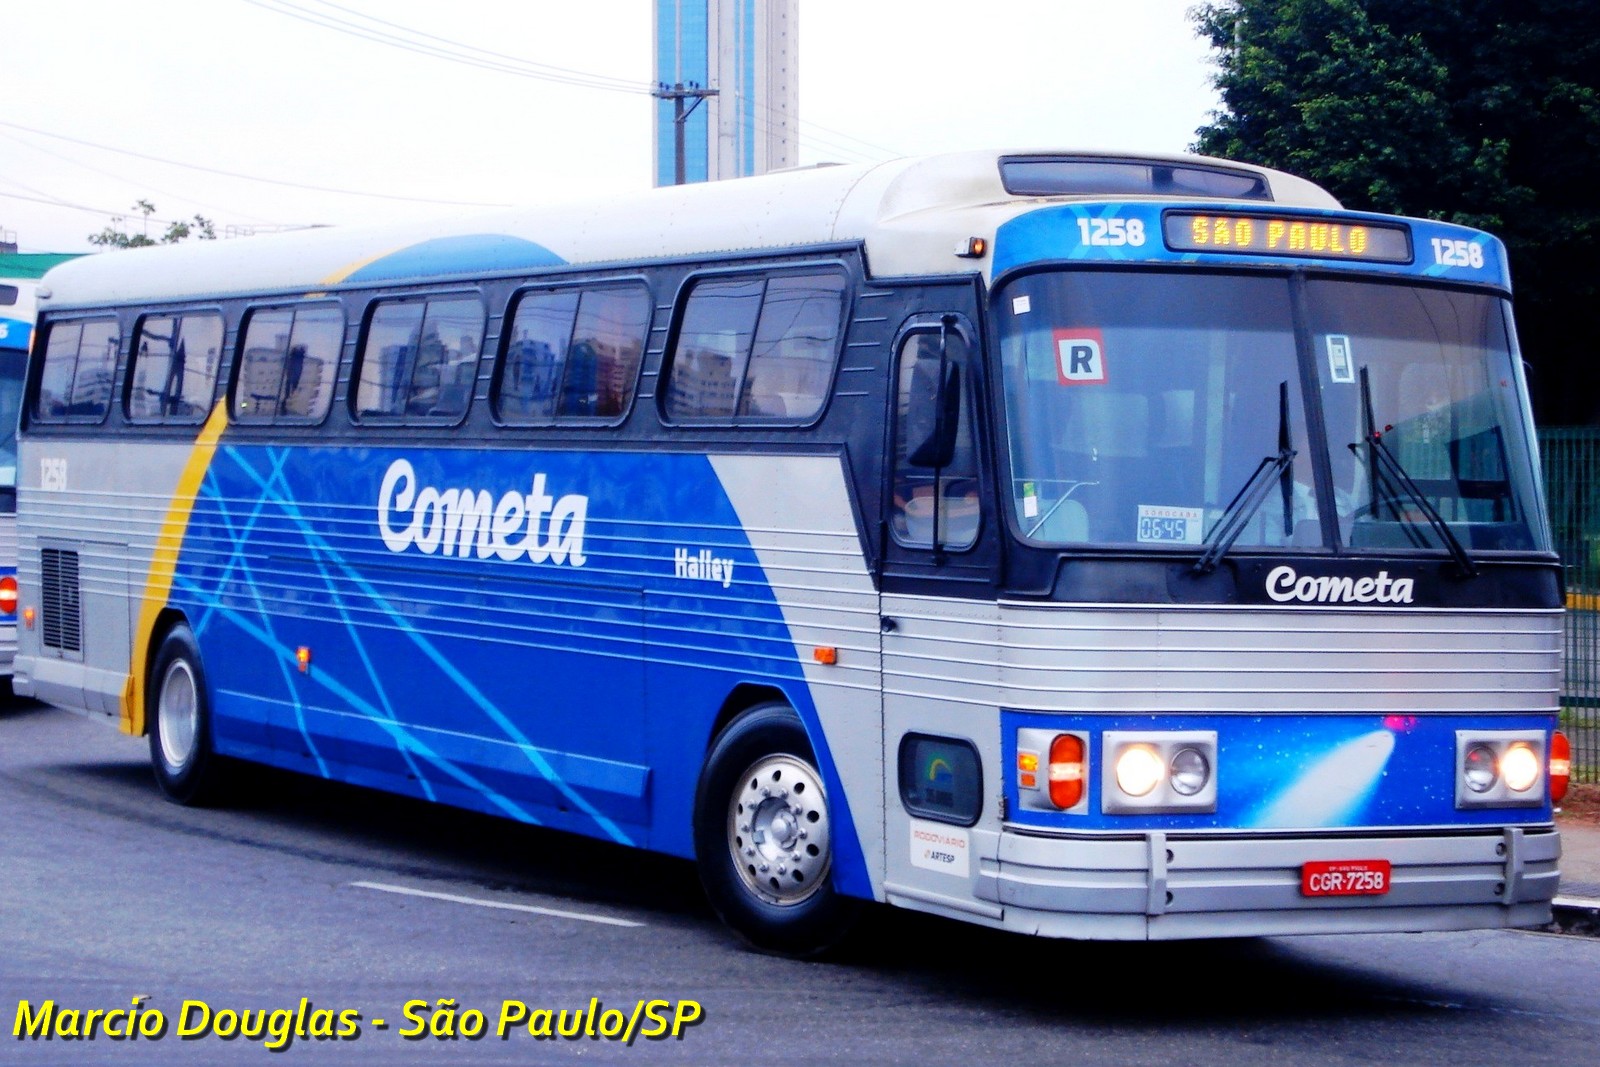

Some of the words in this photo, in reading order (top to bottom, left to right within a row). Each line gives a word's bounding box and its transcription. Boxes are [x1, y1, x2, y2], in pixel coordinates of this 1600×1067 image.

[1077, 217, 1146, 247] 1258
[1267, 220, 1368, 254] PAULO
[1431, 237, 1484, 269] 1258
[1070, 345, 1093, 374] R
[41, 457, 67, 491] 1258
[378, 458, 589, 567] Cometa
[674, 547, 734, 589] Halley
[1265, 565, 1414, 604] Cometa
[931, 850, 956, 864] ARTESP
